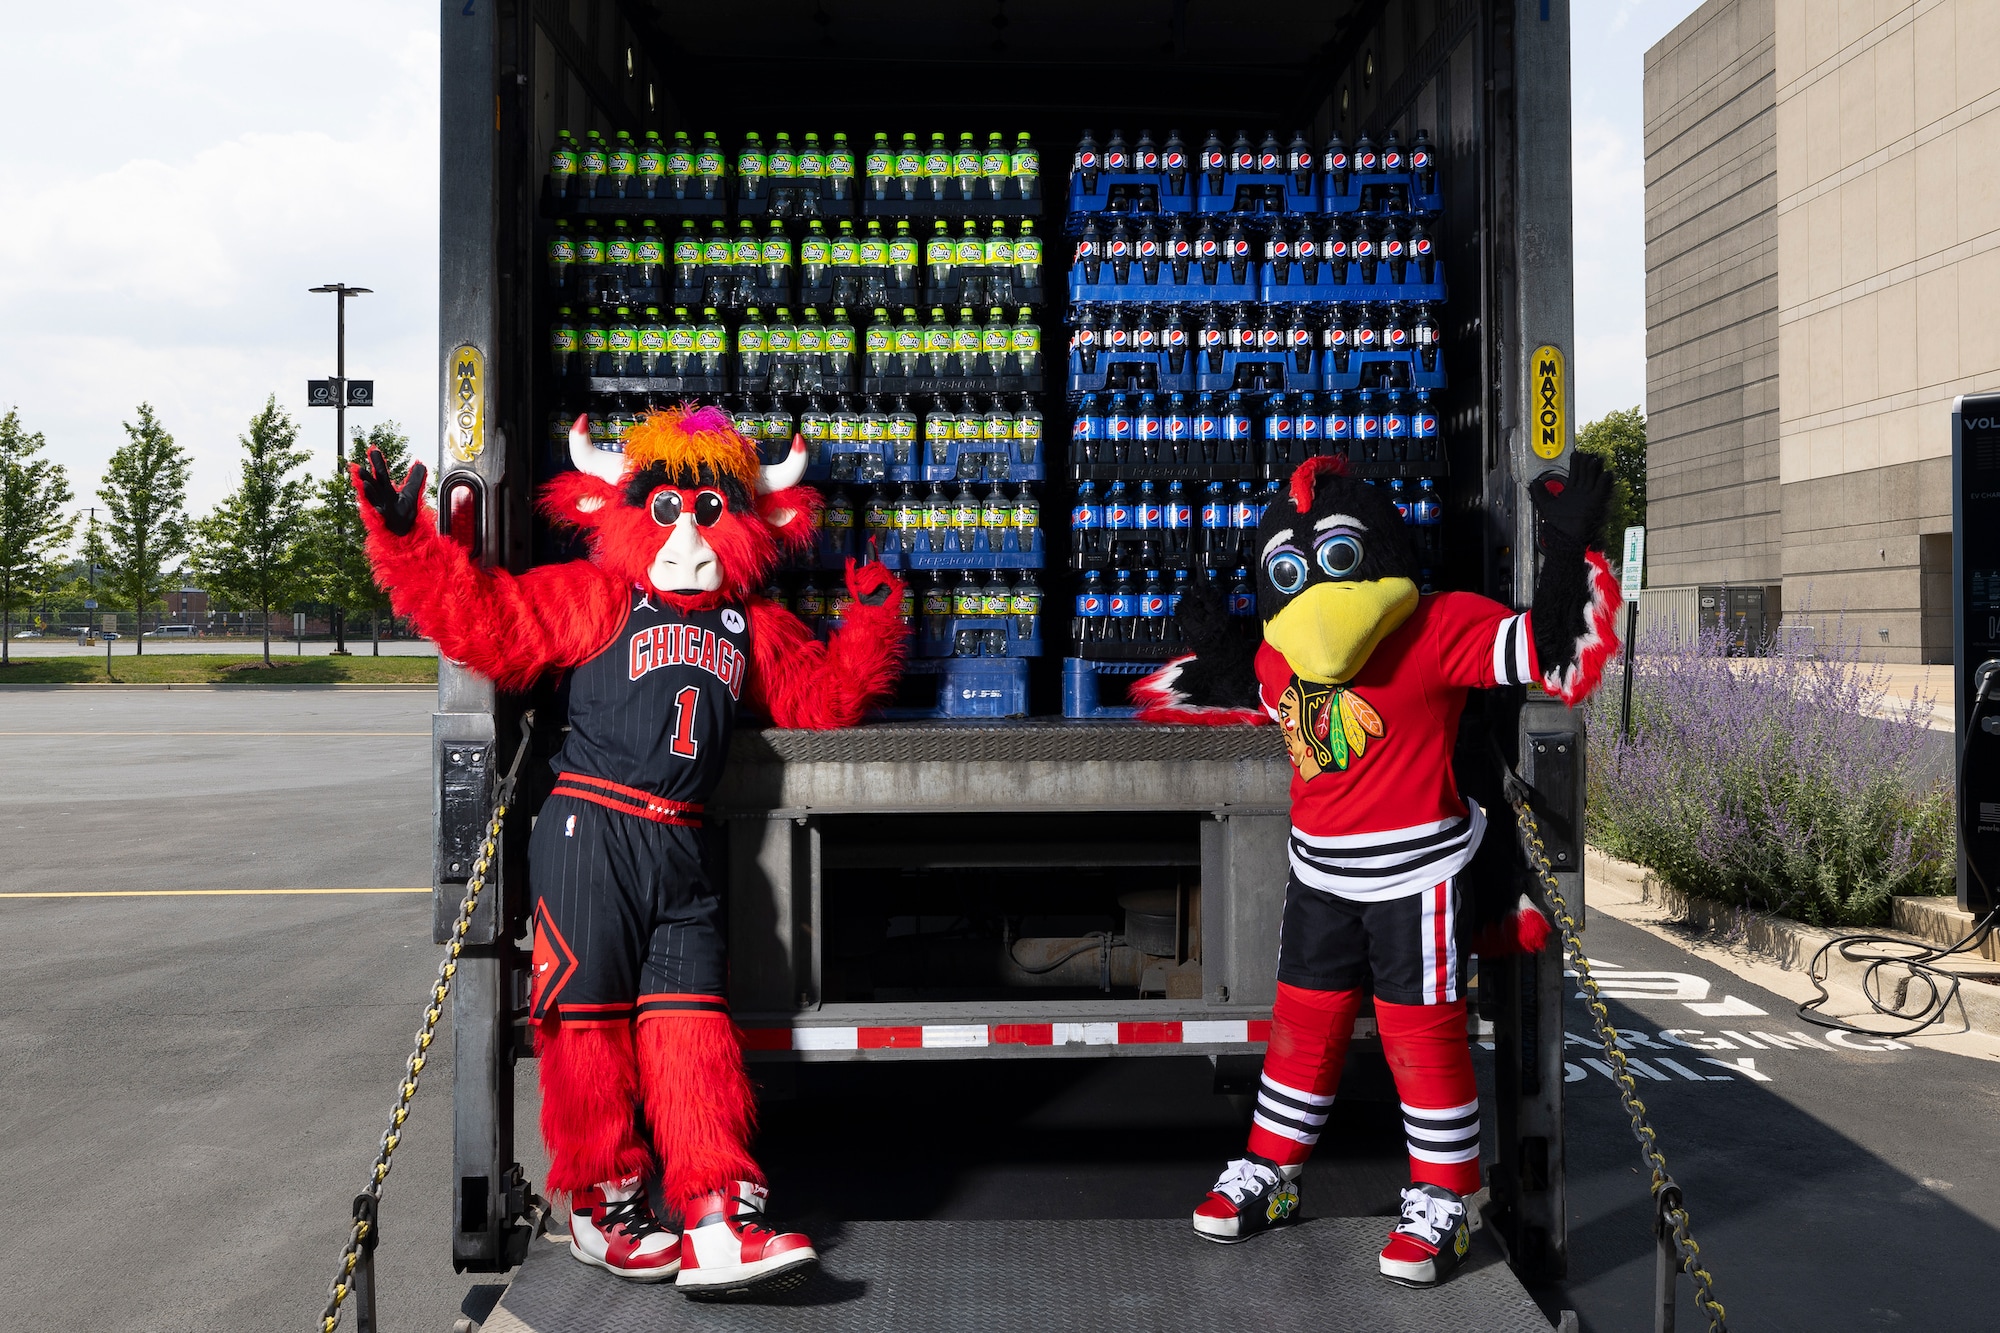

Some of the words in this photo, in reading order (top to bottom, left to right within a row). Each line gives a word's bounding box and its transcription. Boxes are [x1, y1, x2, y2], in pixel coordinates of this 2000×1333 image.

[550, 155, 570, 169] Starry
[582, 155, 604, 169] Starry
[608, 155, 628, 170] Starry
[638, 156, 658, 170] Starry
[668, 156, 690, 170] Starry
[698, 156, 718, 170] Starry
[740, 156, 762, 172] Starry
[770, 156, 792, 172] Starry
[800, 156, 822, 172] Starry
[830, 156, 852, 172] Starry
[866, 157, 887, 172] Starry
[898, 157, 920, 172] Starry
[926, 157, 948, 172] Starry
[552, 243, 575, 259] Starry
[578, 244, 598, 259] Starry
[609, 244, 630, 260] Starry
[637, 244, 660, 260] Starry
[678, 244, 700, 260] Starry
[707, 244, 729, 260] Starry
[764, 244, 786, 260] Starry
[803, 244, 825, 260] Starry
[832, 244, 854, 260] Starry
[861, 244, 882, 260] Starry
[890, 244, 911, 260] Starry
[930, 244, 952, 260] Starry
[960, 244, 982, 260] Starry
[1018, 244, 1040, 260] Starry
[551, 332, 572, 346] Starry
[582, 332, 604, 346] Starry
[610, 332, 632, 348] Starry
[642, 332, 664, 348] Starry
[671, 332, 696, 348] Starry
[699, 332, 721, 348] Starry
[740, 332, 762, 348] Starry
[770, 332, 792, 348] Starry
[800, 332, 822, 348] Starry
[827, 332, 850, 348] Starry
[868, 333, 888, 348] Starry
[898, 333, 922, 348] Starry
[986, 332, 1008, 348] Starry
[1014, 332, 1036, 348] Starry
[457, 361, 476, 447] MAXON
[1539, 360, 1557, 445] MAXON
[738, 421, 760, 436] Starry
[767, 421, 789, 436] Starry
[890, 421, 912, 436] Starry
[958, 420, 982, 436] Starry
[987, 420, 1009, 436] Starry
[1016, 420, 1038, 436] Starry
[827, 509, 850, 524] Starry
[867, 509, 889, 524] Starry
[800, 597, 820, 612] Starry
[927, 597, 949, 612] Starry
[629, 624, 745, 701] CHICAGO
[670, 685, 700, 760] 1
